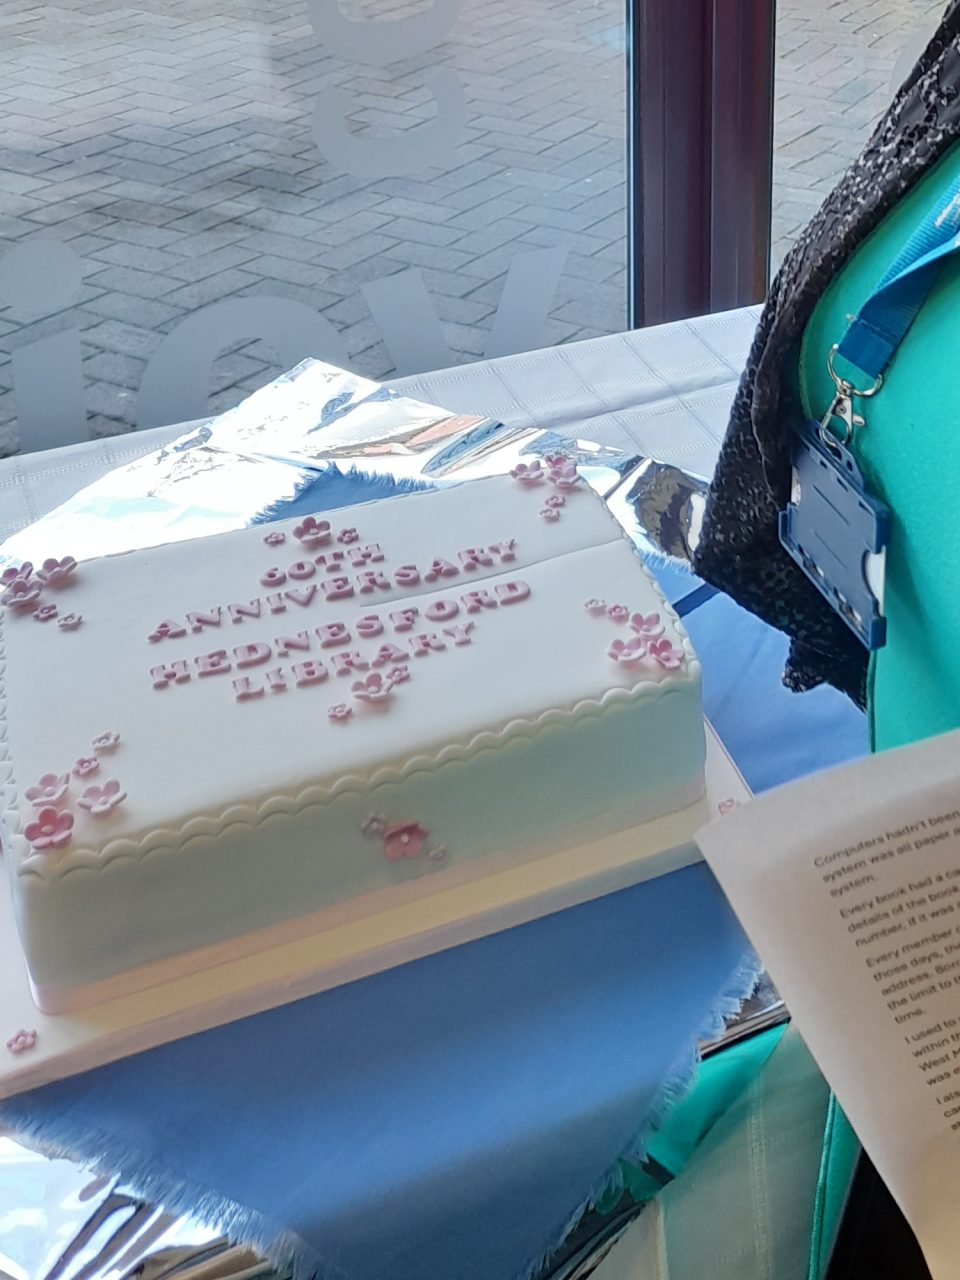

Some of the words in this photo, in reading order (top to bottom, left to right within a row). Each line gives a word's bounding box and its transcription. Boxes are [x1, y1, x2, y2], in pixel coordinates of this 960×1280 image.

[147, 538, 519, 643] ANNIVERSARY
[260, 542, 386, 587] 60TH
[148, 580, 532, 690] HEDNESFORD
[231, 620, 476, 702] LIBRARY
